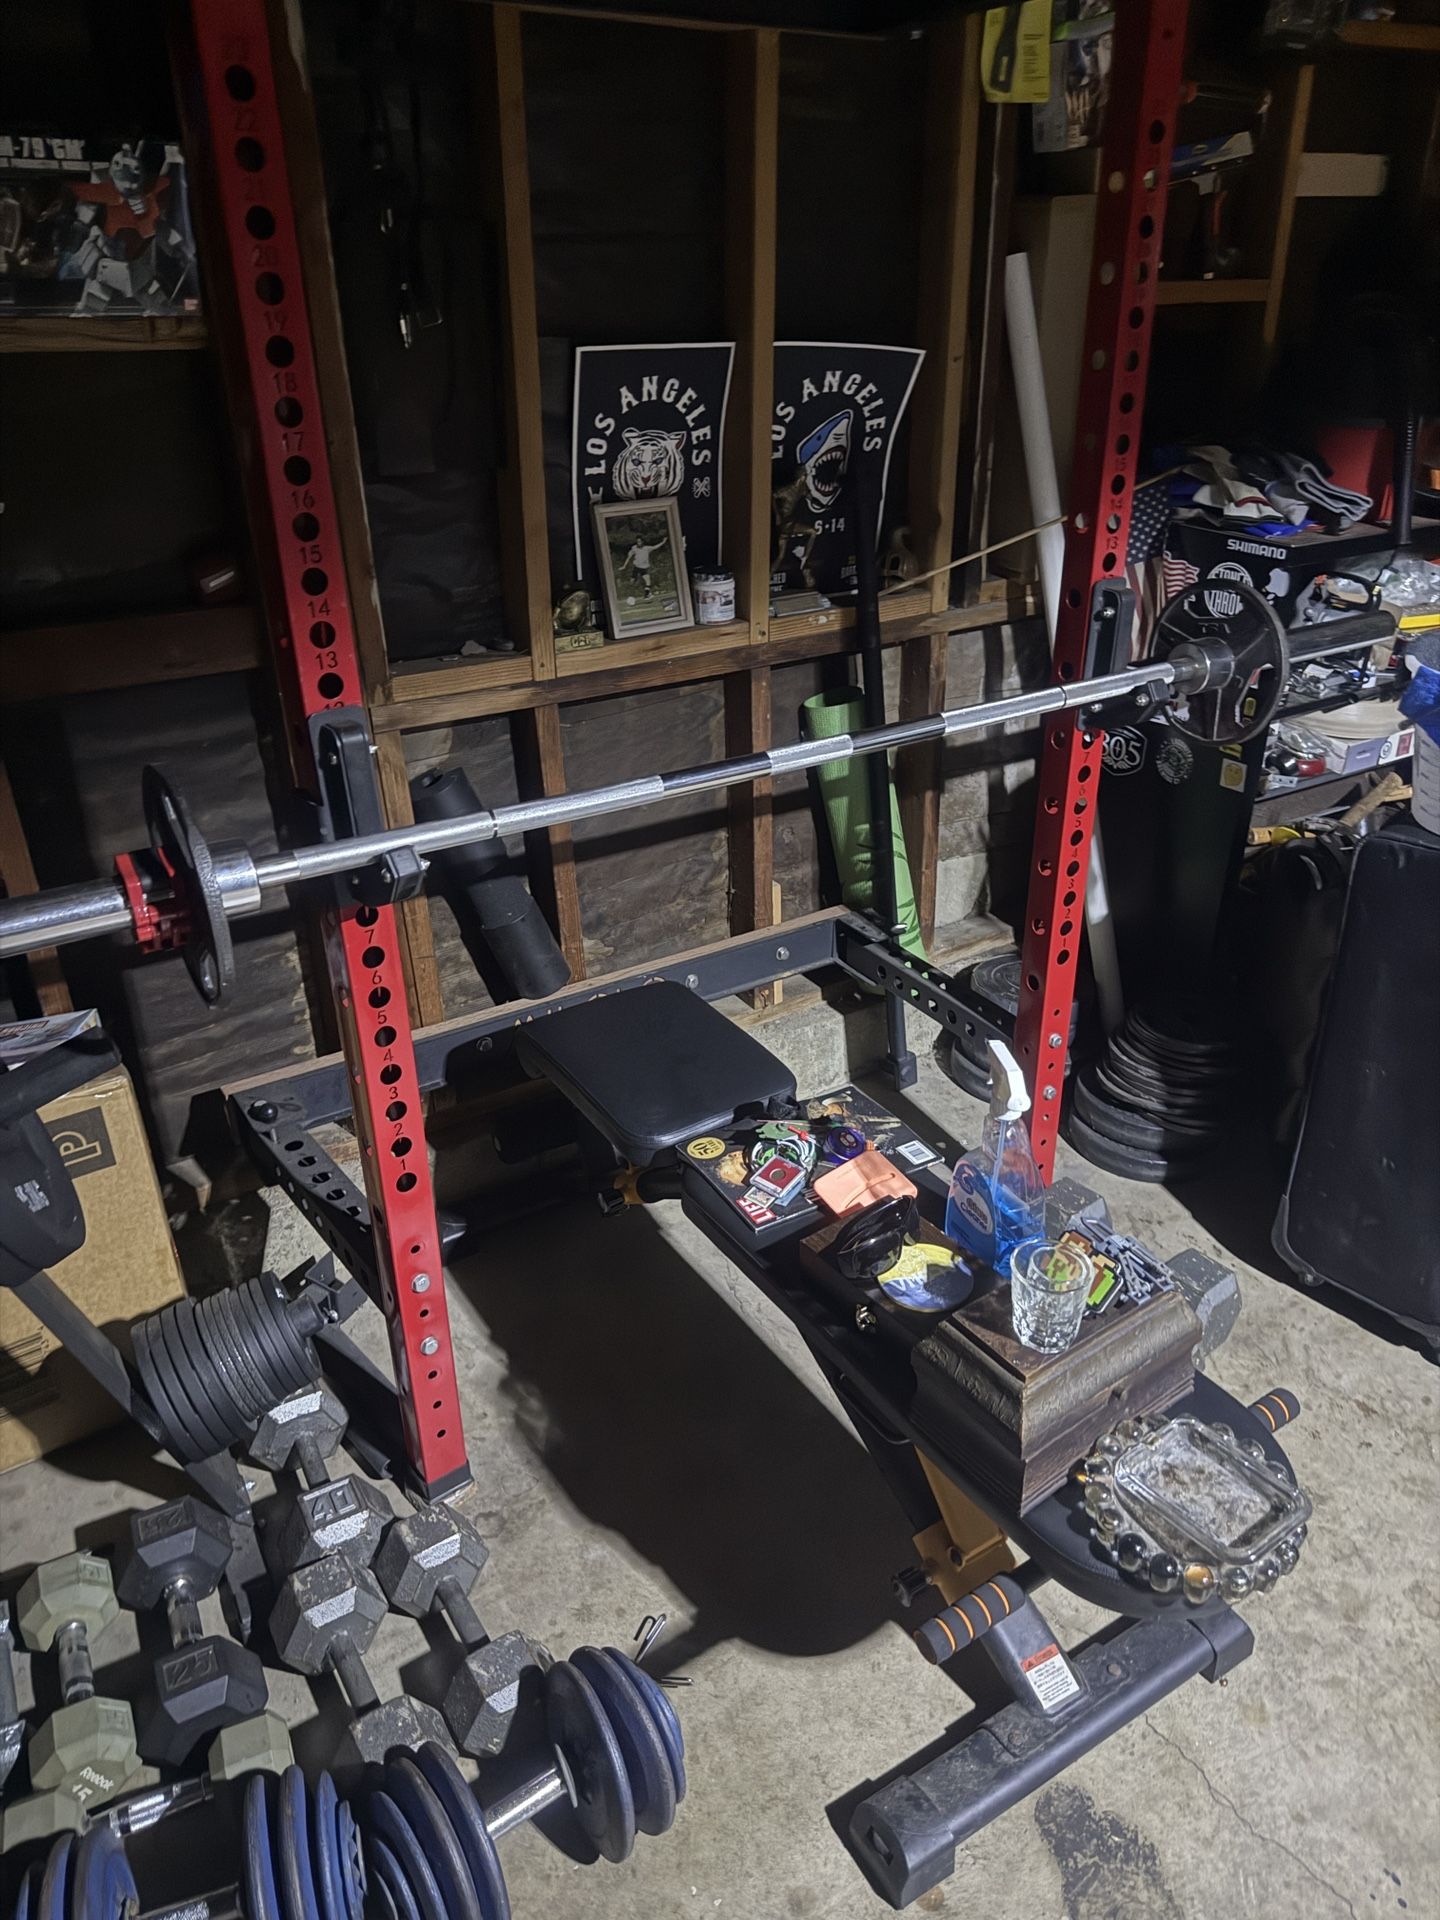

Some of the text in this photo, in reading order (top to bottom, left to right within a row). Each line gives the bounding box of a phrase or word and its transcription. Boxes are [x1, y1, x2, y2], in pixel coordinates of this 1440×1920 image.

[263, 309, 288, 331] 19
[272, 372, 297, 393] 18
[800, 369, 888, 453] ANGELES
[584, 374, 713, 476] LOS ANGELES
[281, 431, 305, 452] 17
[290, 490, 315, 511] 16
[299, 546, 322, 564] 15
[1226, 538, 1287, 560] SHIMANO
[307, 599, 331, 617] 14
[314, 649, 338, 670] 13
[1083, 751, 1090, 763] 7
[1075, 816, 1082, 828] 5
[1068, 879, 1075, 889] 3
[1064, 908, 1071, 919] 2
[364, 929, 375, 944] 7
[371, 969, 383, 985] 6
[377, 1009, 388, 1025] 5
[383, 1048, 394, 1062] 4
[388, 1086, 399, 1100] 3
[394, 1123, 404, 1137] 2
[400, 1159, 407, 1171] 1
[736, 1197, 775, 1224] LIFE
[311, 1486, 355, 1521] 40
[169, 1646, 216, 1690] 25
[79, 1765, 115, 1793] Reebok
[72, 1782, 94, 1803] 15
